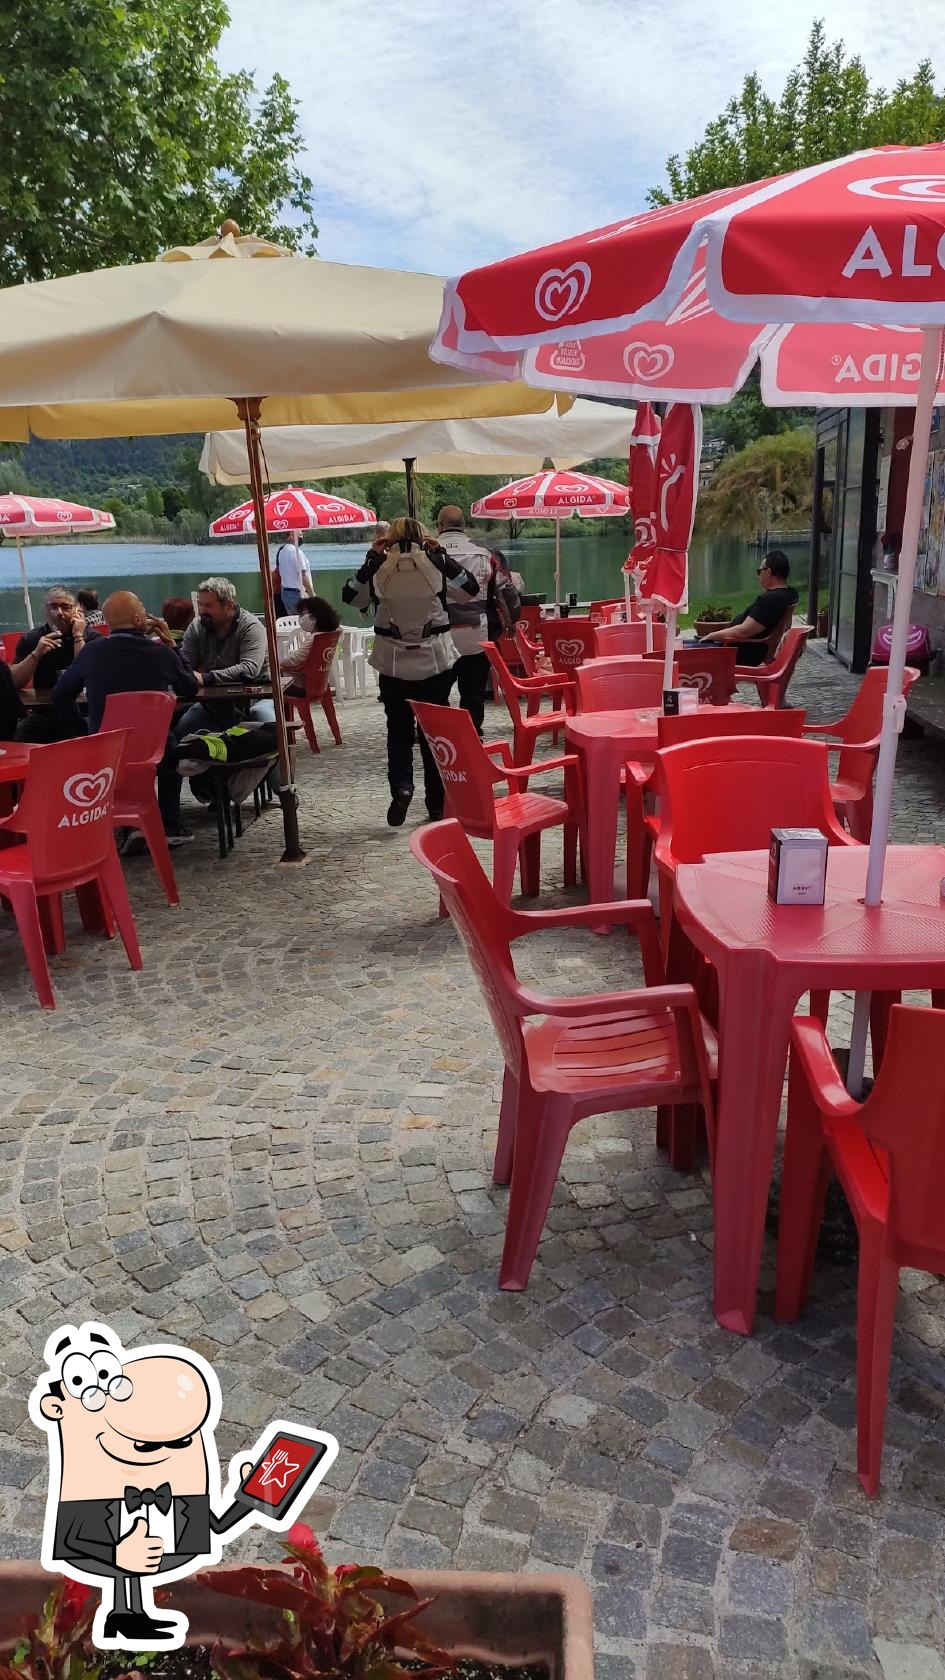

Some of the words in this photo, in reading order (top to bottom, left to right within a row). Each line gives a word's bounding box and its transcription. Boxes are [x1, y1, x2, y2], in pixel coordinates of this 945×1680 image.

[557, 495, 593, 505] ALGIDA
[328, 514, 354, 524] ALGIDA
[559, 657, 584, 665] ALGID
[57, 804, 107, 829] ALGIDA
